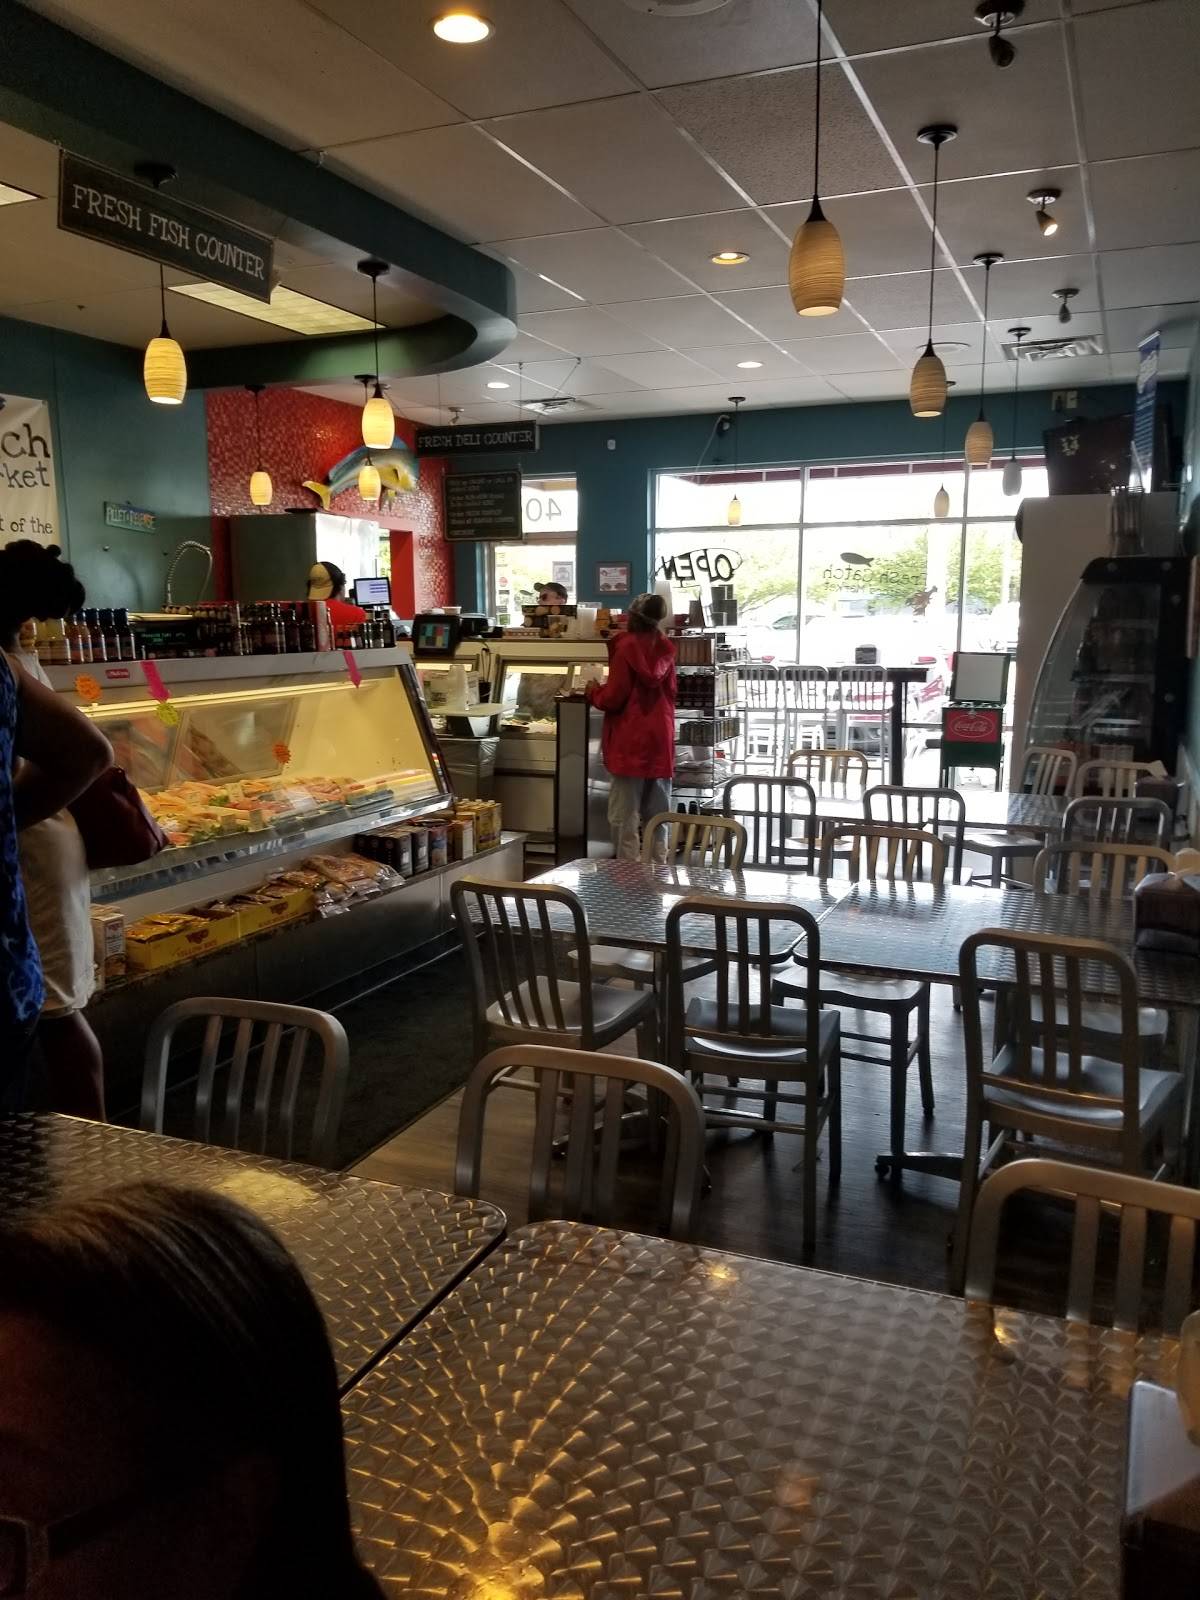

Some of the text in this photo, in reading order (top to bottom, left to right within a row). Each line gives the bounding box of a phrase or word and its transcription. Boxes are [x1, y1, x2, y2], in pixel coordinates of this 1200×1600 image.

[72, 184, 265, 280] FRESH FISH COUNTER
[0, 423, 51, 459] ch
[417, 430, 534, 448] FRESH DELI COUNTER
[10, 517, 26, 533] of
[30, 516, 54, 535] the
